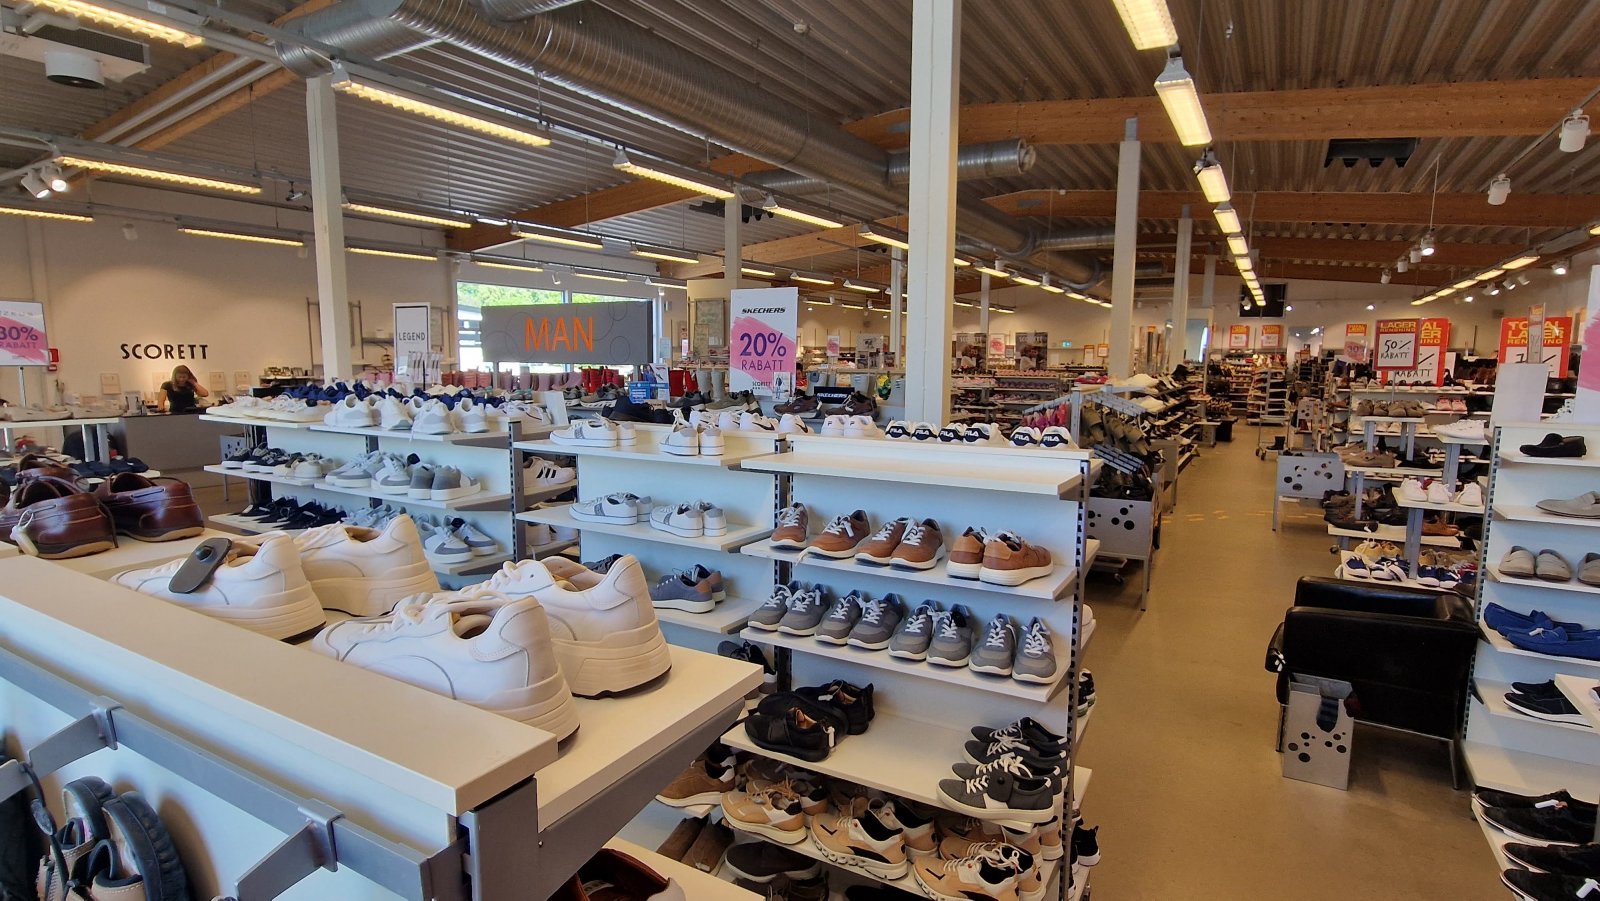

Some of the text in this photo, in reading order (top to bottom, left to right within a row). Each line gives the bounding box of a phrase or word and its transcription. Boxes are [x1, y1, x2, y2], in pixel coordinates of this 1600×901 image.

[741, 307, 786, 315] SKECHERS
[1380, 321, 1417, 329] LAGER
[0, 326, 39, 341] 30%
[398, 332, 426, 341] LEGEND
[524, 316, 594, 353] MAN
[740, 332, 787, 357] 20%
[1384, 339, 1412, 353] 50%
[120, 343, 208, 360] SCORETT
[742, 360, 785, 371] RABATT
[940, 430, 954, 438] FILA
[1013, 433, 1030, 441] FILA
